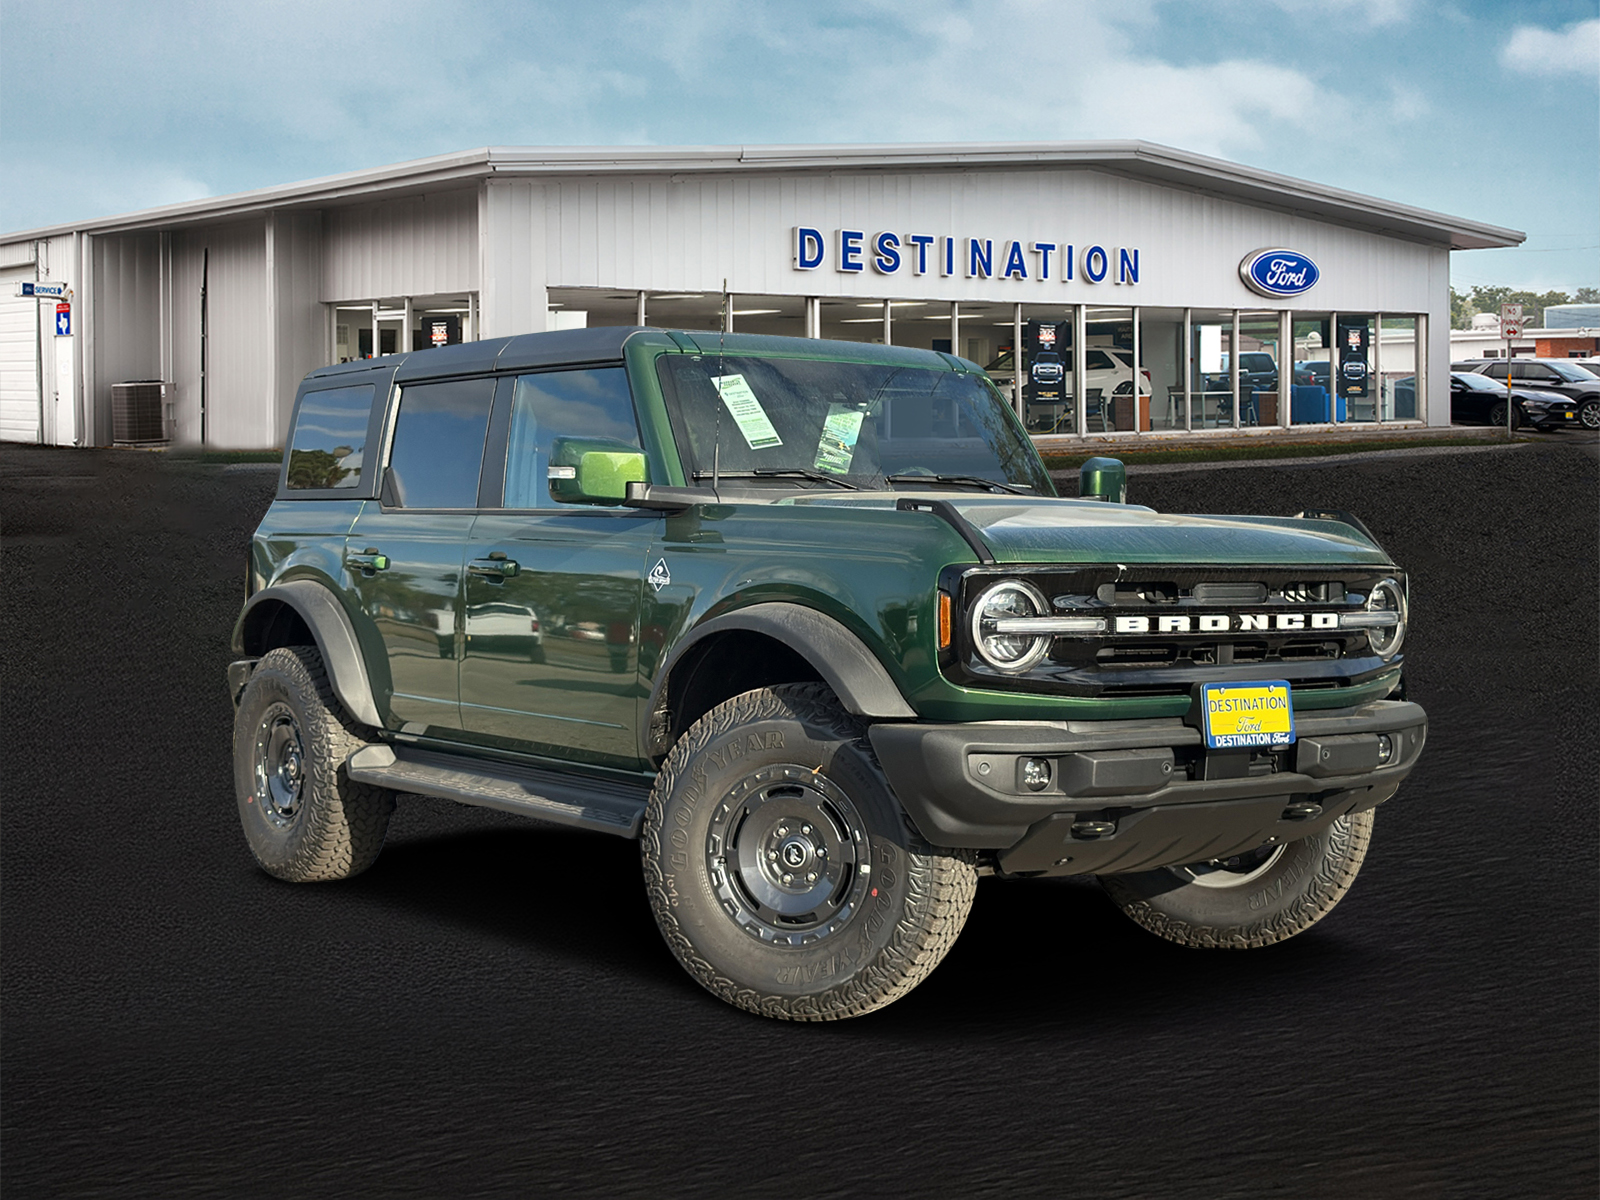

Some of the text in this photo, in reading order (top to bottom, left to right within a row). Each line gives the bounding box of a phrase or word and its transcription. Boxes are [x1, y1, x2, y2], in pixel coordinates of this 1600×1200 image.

[793, 226, 1141, 285] DESTINATION
[1266, 258, 1307, 287] Ford
[35, 286, 57, 295] SERVICE
[1115, 613, 1339, 633] BRONCO
[1209, 696, 1287, 713] DESTINATION
[1236, 716, 1262, 732] Ford
[1215, 732, 1290, 747] DESTINATION Ford
[1248, 854, 1310, 911] YEAR
